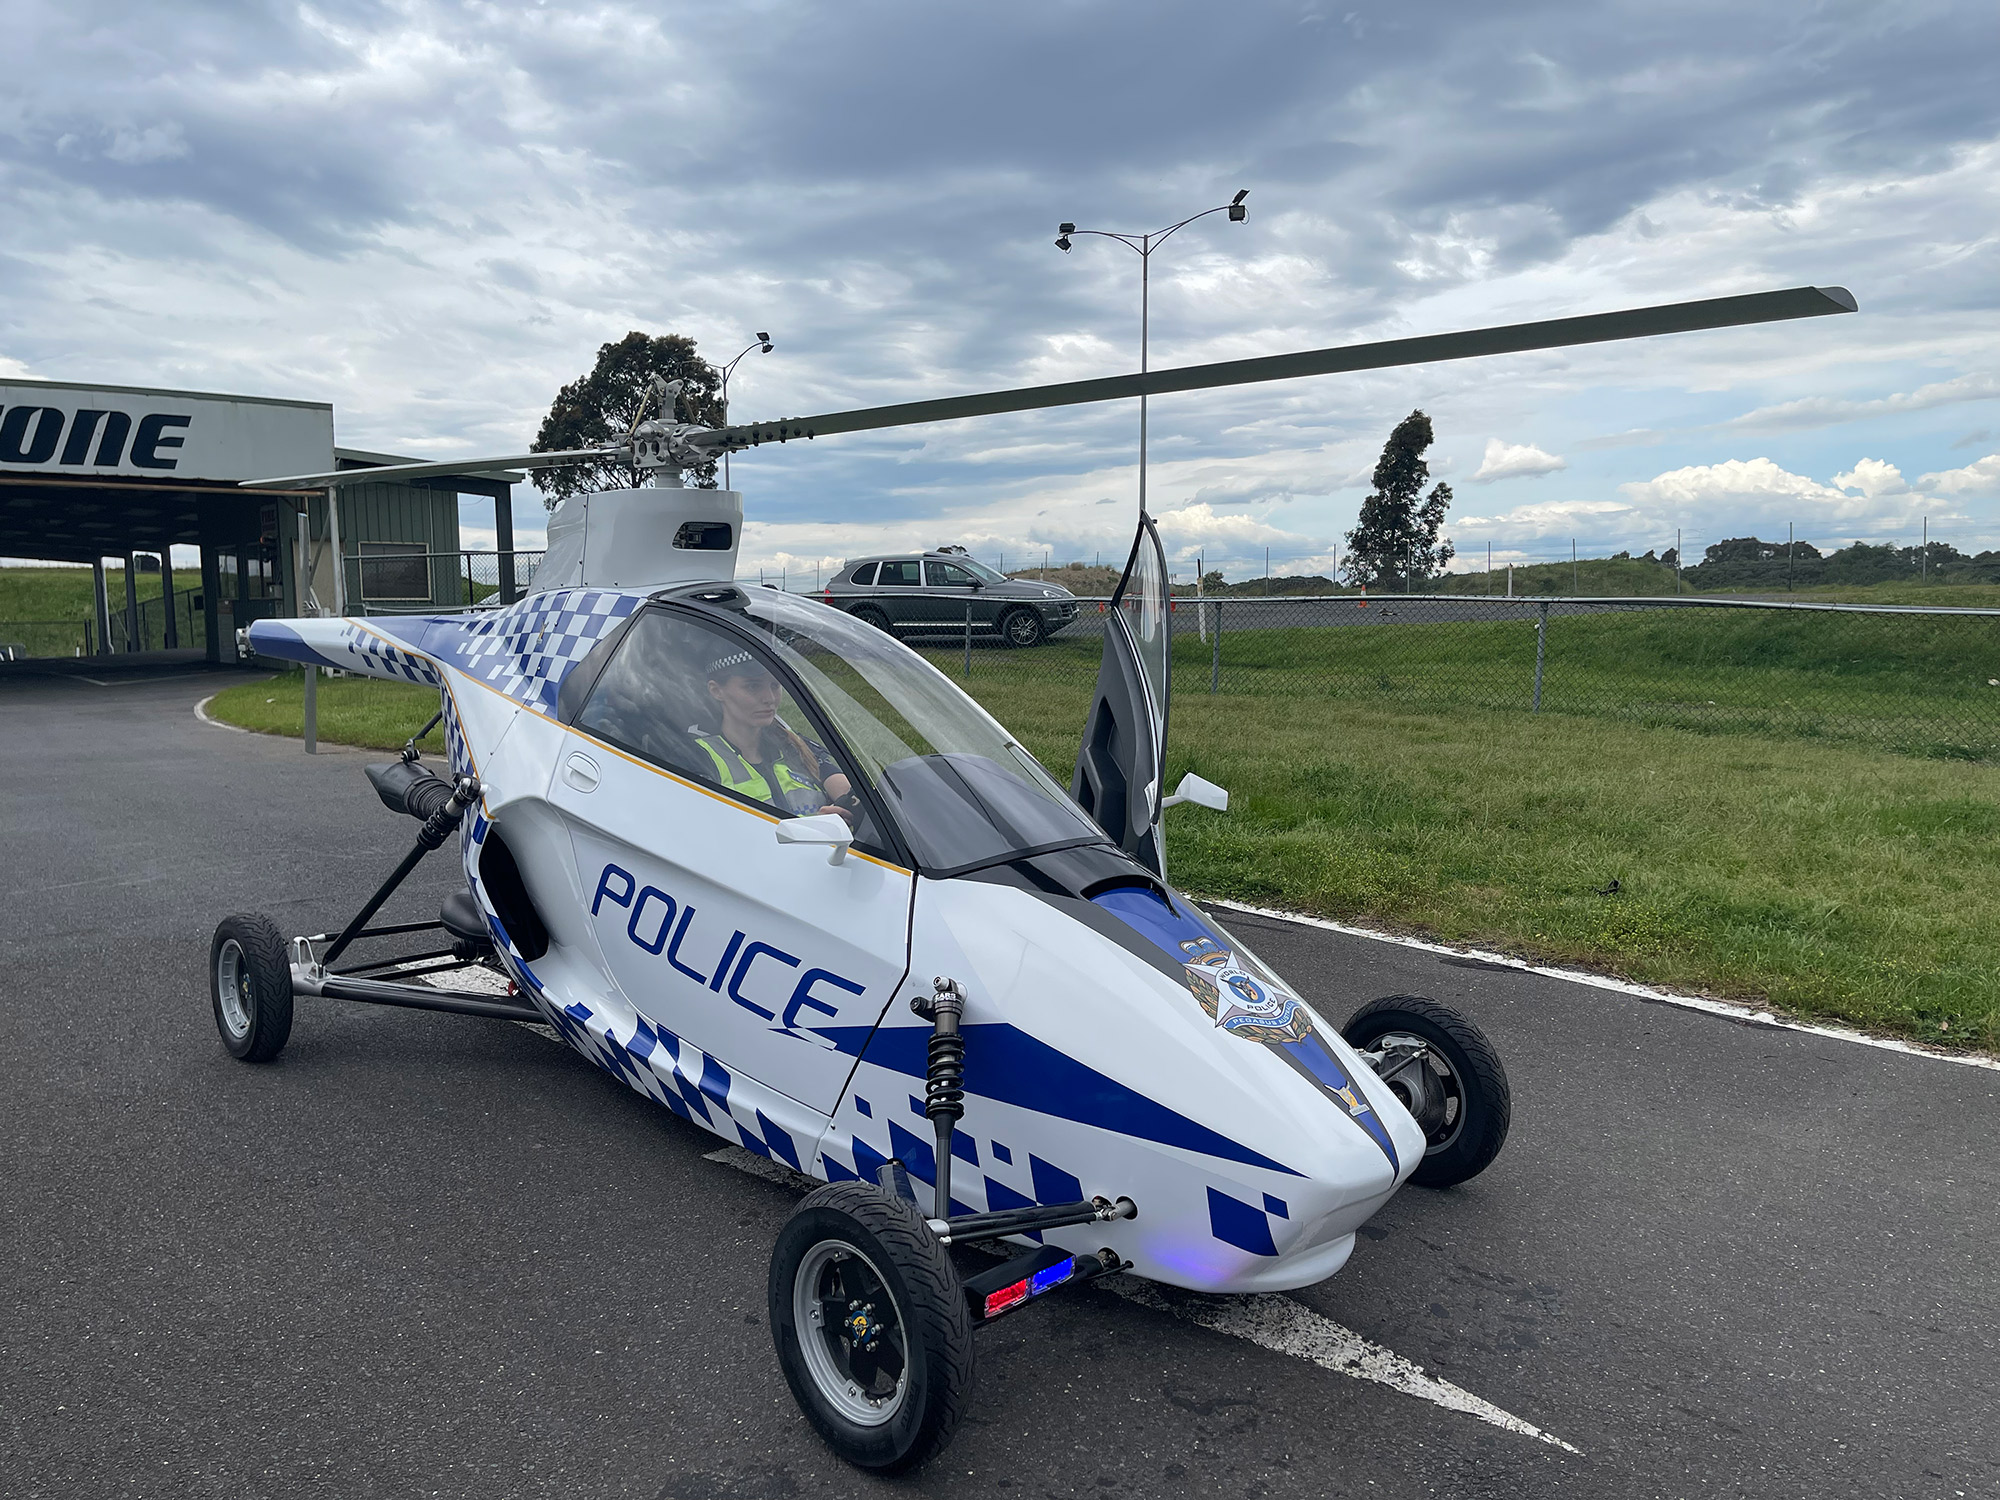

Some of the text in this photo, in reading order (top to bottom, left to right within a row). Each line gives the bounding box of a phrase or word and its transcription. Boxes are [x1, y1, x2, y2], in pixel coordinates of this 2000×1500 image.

[0, 404, 192, 470] ONE
[591, 863, 867, 1051] POLICE
[1219, 969, 1246, 979] WORLD
[1246, 998, 1276, 1012] POLICE
[1232, 1018, 1278, 1026] PEGASUS
